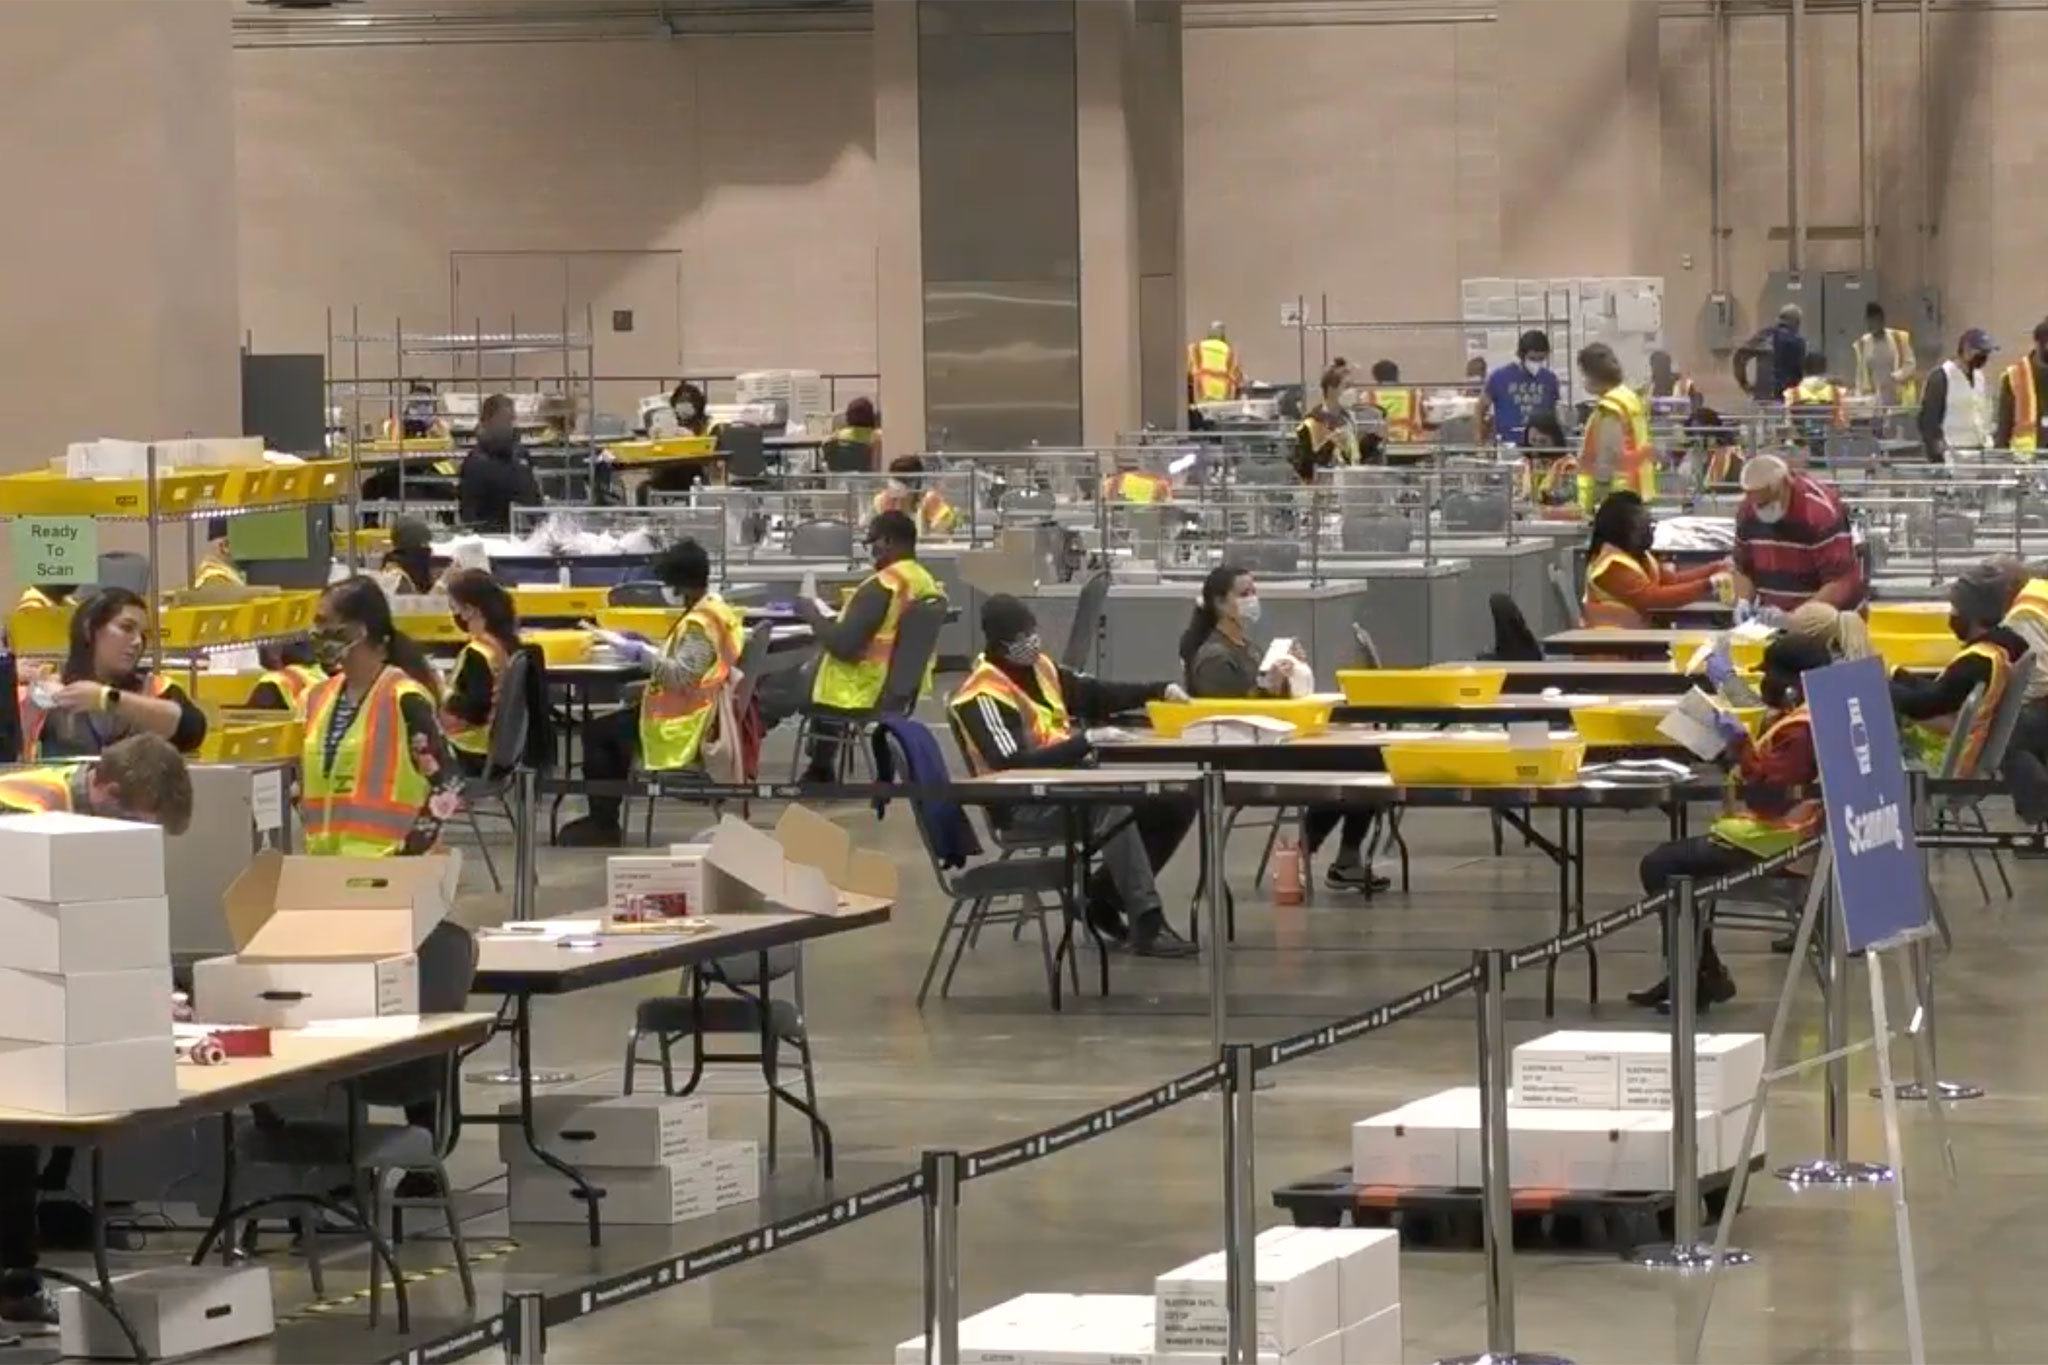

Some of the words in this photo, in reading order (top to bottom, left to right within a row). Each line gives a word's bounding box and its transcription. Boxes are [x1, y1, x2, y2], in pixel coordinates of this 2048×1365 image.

[31, 524, 78, 541] Ready
[46, 543, 65, 557] To
[37, 562, 74, 576] Scan
